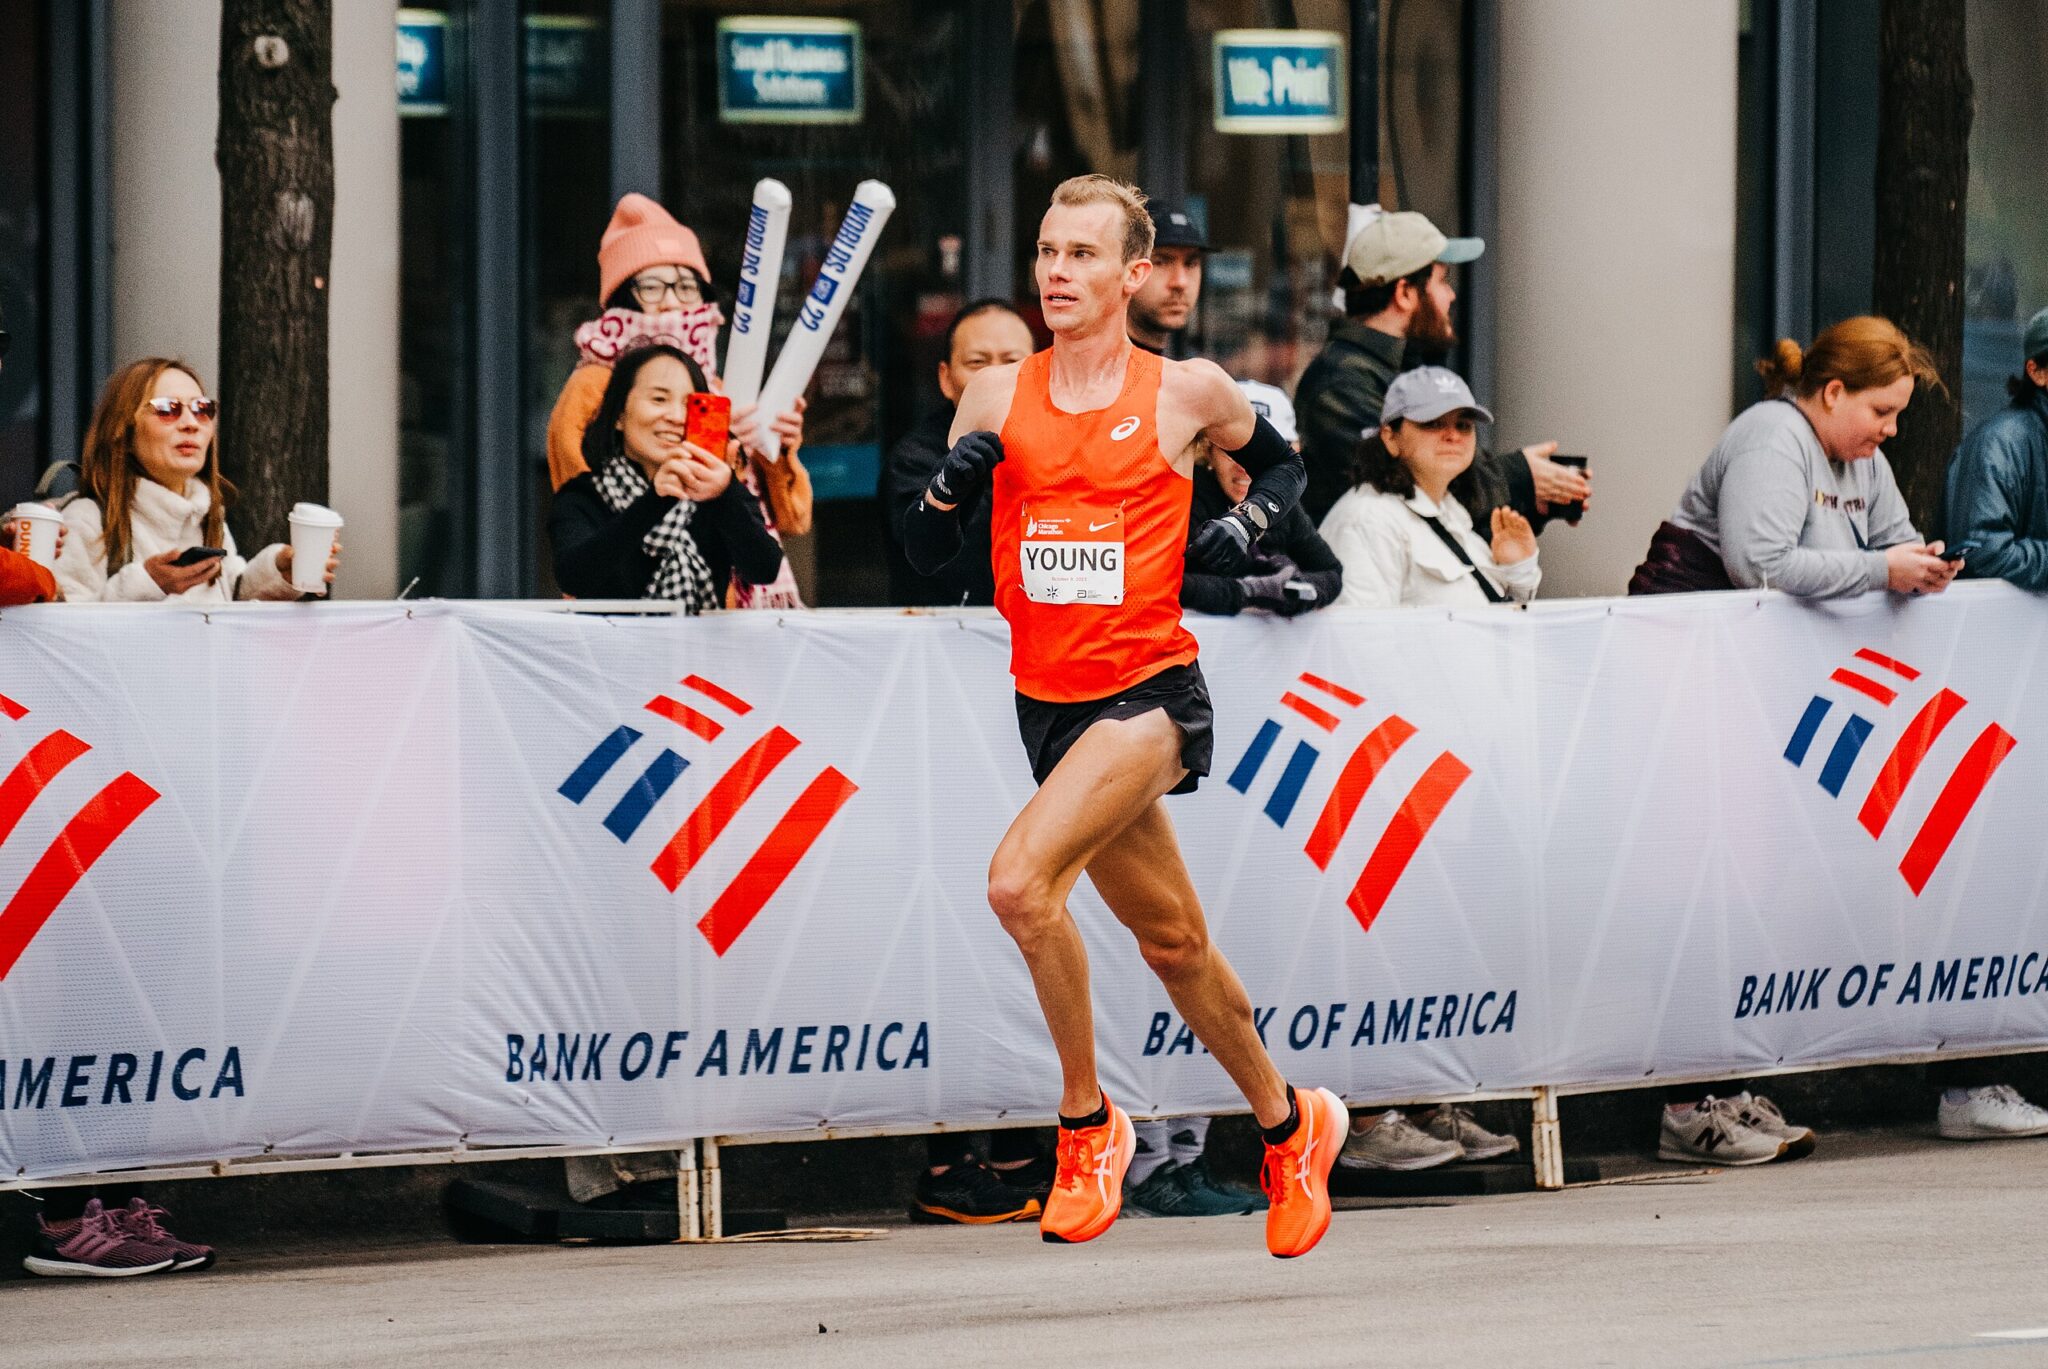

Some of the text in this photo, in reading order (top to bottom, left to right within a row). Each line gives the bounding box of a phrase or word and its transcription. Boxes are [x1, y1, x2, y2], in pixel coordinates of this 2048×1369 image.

[1228, 57, 1270, 106] We
[20, 521, 31, 557] DUN
[1026, 547, 1117, 572] YOUNG
[1734, 967, 1831, 1019] BANK
[1837, 963, 1895, 1009] OF
[1142, 990, 1517, 1057] BAK OF AMERICA
[0, 1046, 244, 1110] MERICA
[505, 1022, 929, 1082] BANK OF AMERICA
